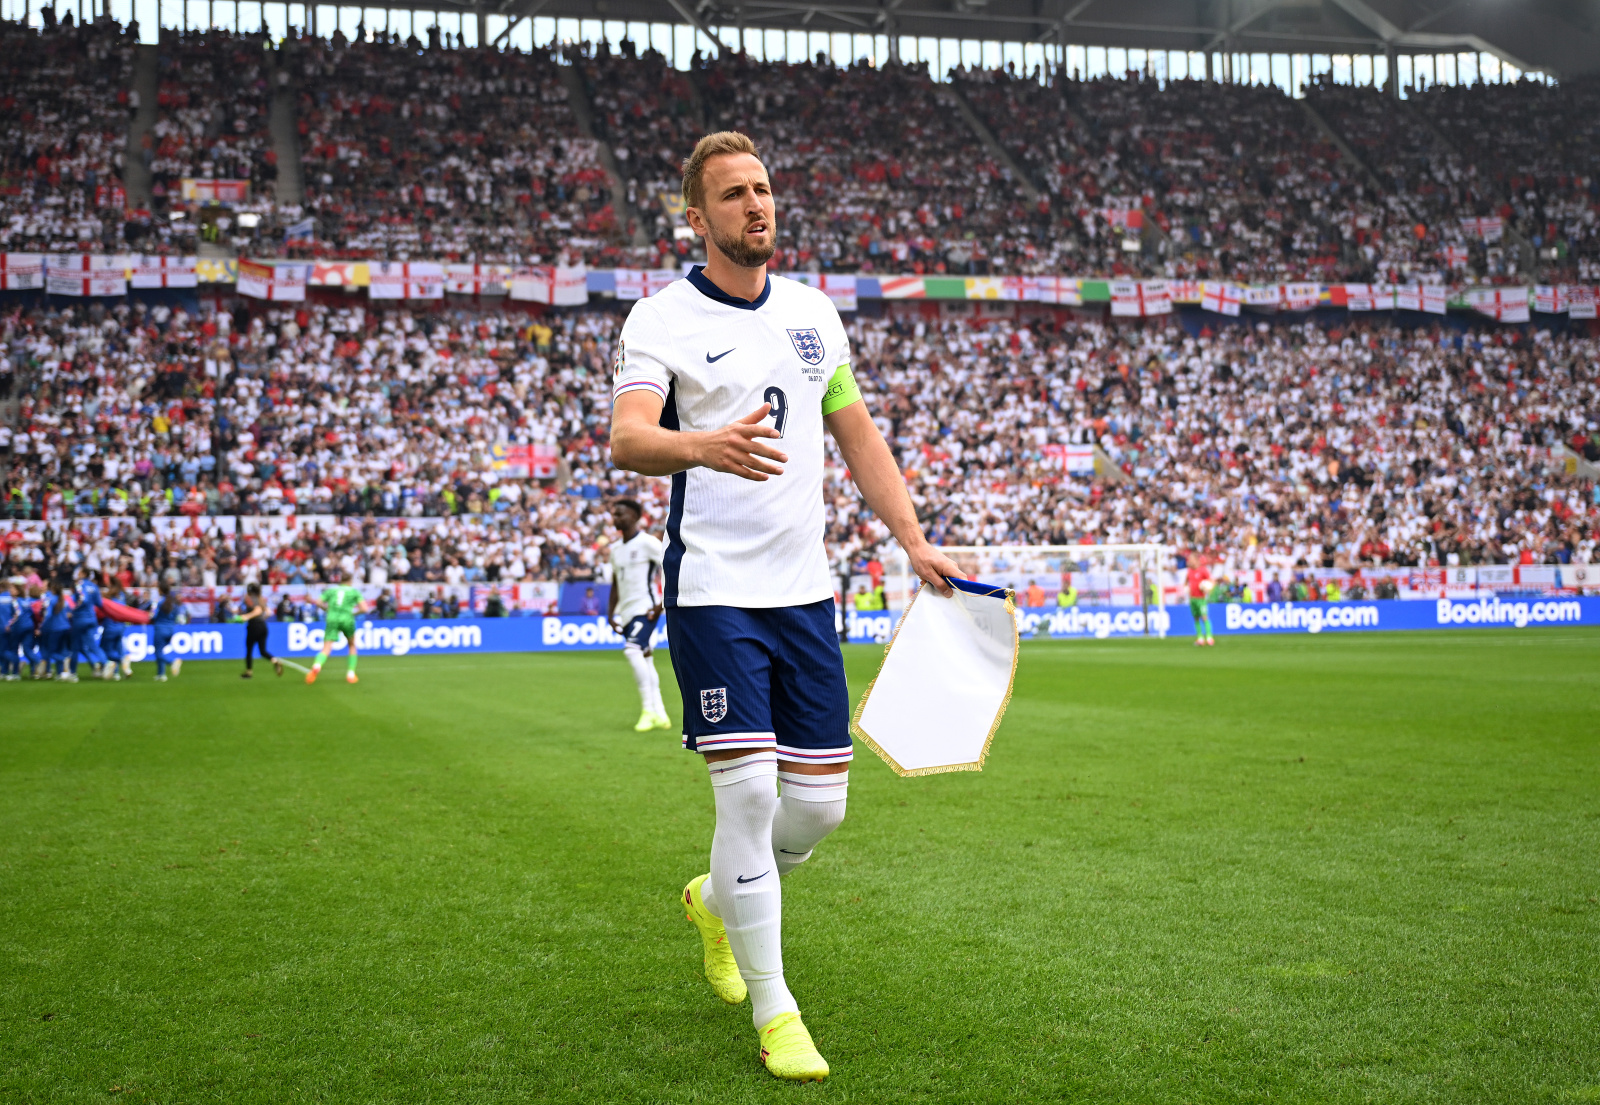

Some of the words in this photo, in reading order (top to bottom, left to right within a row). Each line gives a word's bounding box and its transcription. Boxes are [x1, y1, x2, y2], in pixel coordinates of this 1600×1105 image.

[823, 384, 843, 399] PECT
[764, 386, 788, 439] 9
[1226, 602, 1379, 633] Booking.com
[1437, 597, 1582, 628] Booking.com
